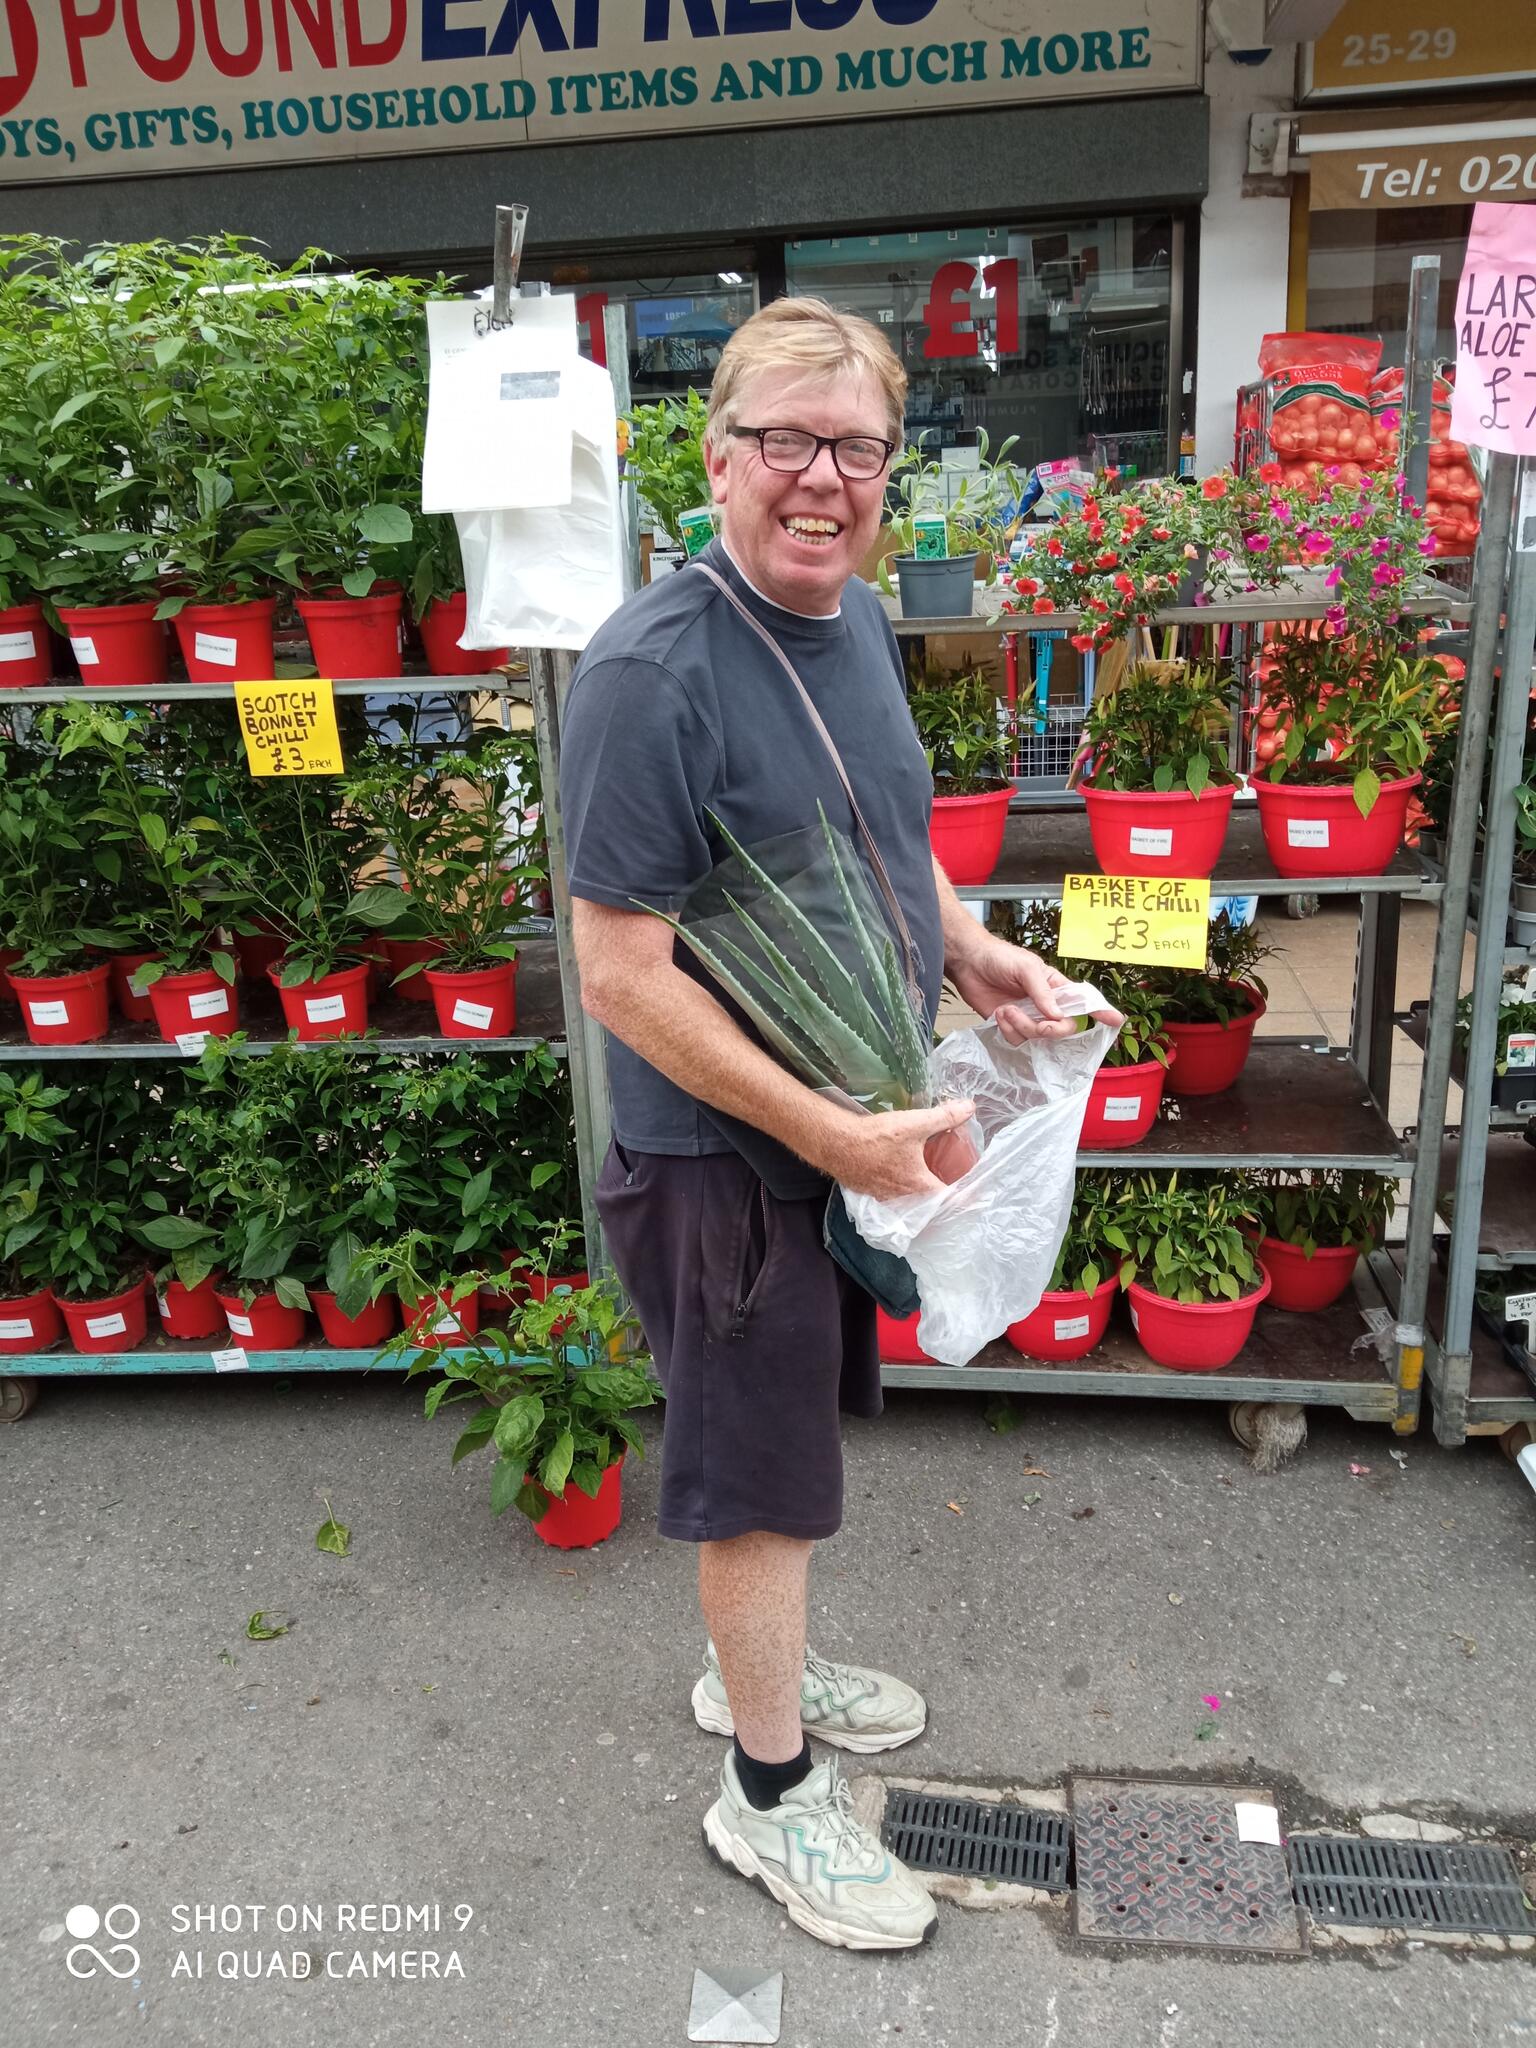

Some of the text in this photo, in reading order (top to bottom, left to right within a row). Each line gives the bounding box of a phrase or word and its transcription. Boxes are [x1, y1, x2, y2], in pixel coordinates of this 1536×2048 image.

[60, 0, 408, 88] POUND
[1341, 27, 1457, 68] 25-29
[0, 28, 1151, 163] YS, GIFTS, HOUSEHOLD ITEMS AND MUCH MORE
[1356, 158, 1441, 199] Tel:
[923, 258, 1019, 359] £1
[1460, 319, 1532, 359] ALOE
[242, 691, 317, 716] SCOTCH
[245, 711, 317, 736] BONNET
[255, 729, 309, 749] CHILLI
[271, 747, 332, 773] £3 EACH
[1069, 876, 1187, 897] BASKET OF
[1090, 891, 1200, 913] FIRE CHILLI
[1104, 915, 1191, 950] £3 EACH
